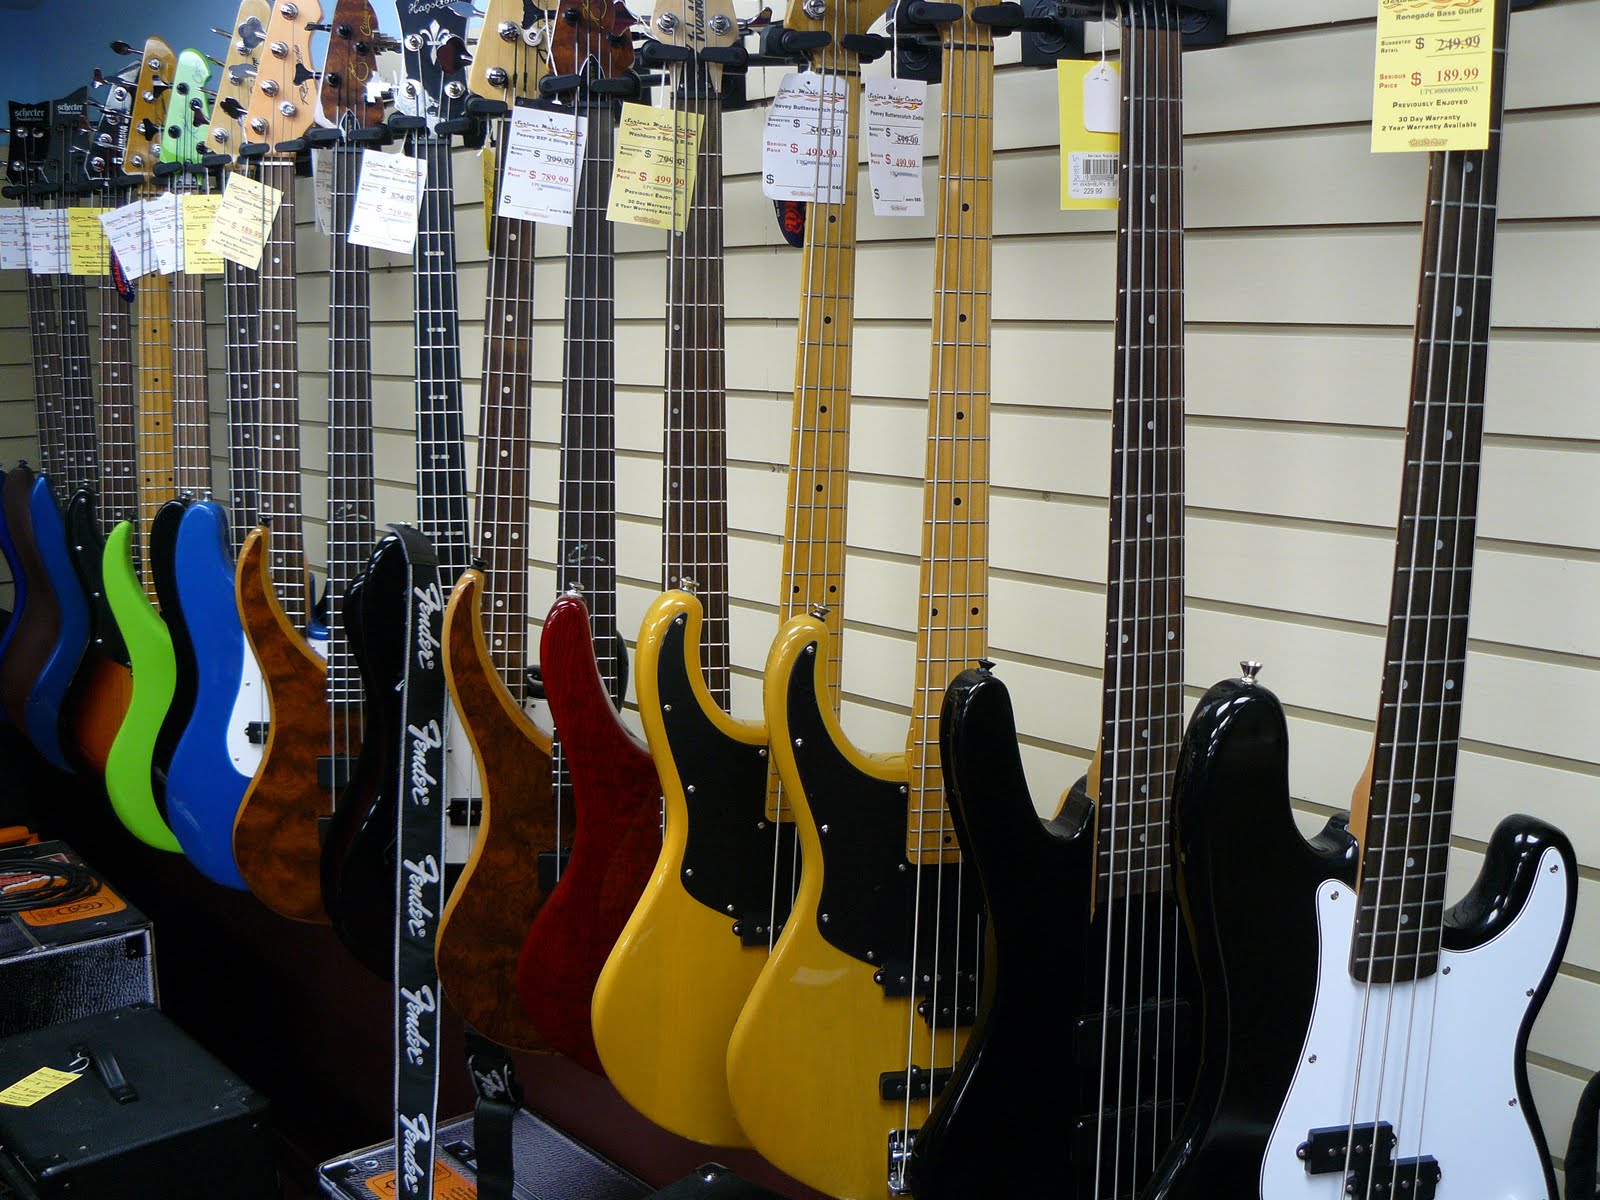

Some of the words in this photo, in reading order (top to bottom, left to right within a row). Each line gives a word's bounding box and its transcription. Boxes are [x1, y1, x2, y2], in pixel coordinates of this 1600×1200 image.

[1396, 10, 1434, 20] Renegade
[1415, 37, 1424, 50] $
[1410, 72, 1422, 87] $
[1436, 68, 1479, 82] 189.99
[793, 119, 800, 128] $
[790, 143, 798, 153] $
[639, 172, 647, 181] $
[766, 174, 774, 184] $
[414, 582, 442, 670] Fender
[408, 719, 442, 806] Fender
[403, 854, 440, 937] Fender
[401, 984, 436, 1064] Fender
[400, 1113, 430, 1194] Fender
